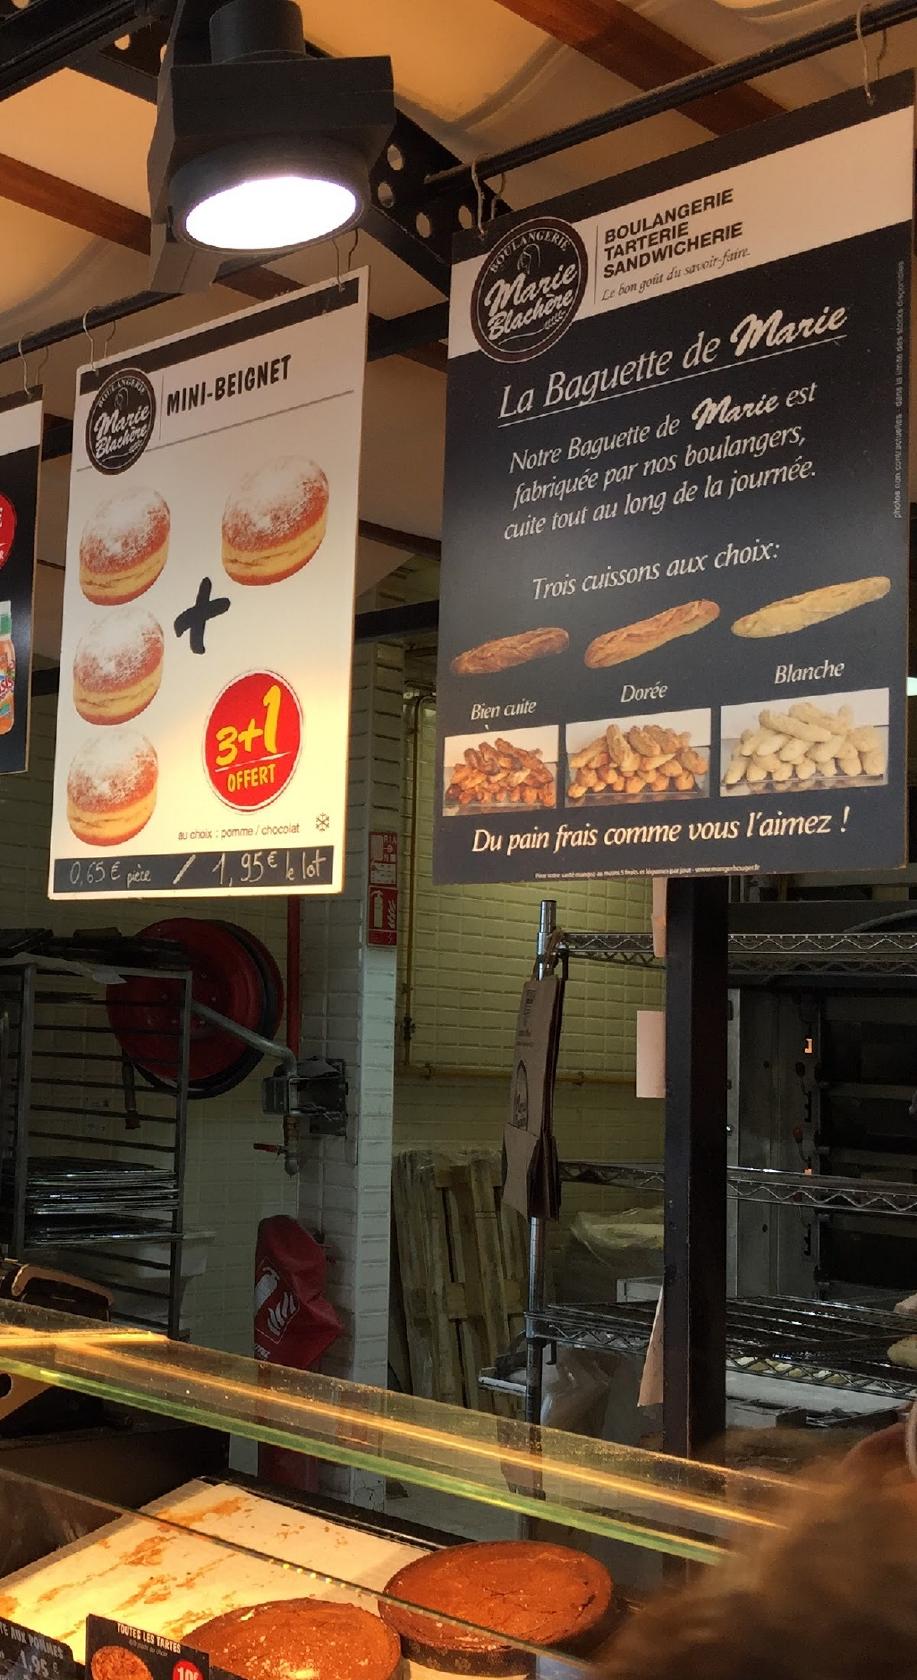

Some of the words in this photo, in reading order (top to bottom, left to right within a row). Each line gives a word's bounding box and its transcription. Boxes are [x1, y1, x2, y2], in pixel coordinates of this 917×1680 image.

[604, 188, 734, 245] BOULANGERIE
[490, 231, 571, 273] BOULANGERIE
[603, 222, 743, 279] SANDWICHERIE
[604, 221, 689, 261] TARTERIE
[484, 263, 578, 317] Marie
[601, 288, 616, 301] Le
[618, 282, 637, 296] bon
[639, 272, 663, 294] goût
[666, 266, 682, 281] du
[487, 289, 574, 341] Blachère
[499, 385, 534, 419] La
[543, 351, 674, 407] Baguette
[683, 331, 722, 370] de
[730, 305, 848, 356] Marie
[167, 354, 291, 416] MINI-BEIGNET
[94, 405, 149, 441] Marie
[95, 423, 148, 459] Blachère
[509, 445, 562, 474] Notre
[567, 422, 651, 461] Baguette
[656, 413, 681, 440] de
[692, 394, 779, 431] Marie
[785, 382, 818, 409] est
[512, 468, 599, 511] fabriquée
[603, 461, 640, 492] par
[643, 451, 678, 475] nos
[684, 423, 807, 468] boulangers,
[504, 514, 546, 540] cuite
[551, 507, 588, 532] tout
[592, 500, 618, 522] au
[623, 488, 667, 516] long
[672, 480, 699, 506] de
[703, 473, 724, 500] la
[728, 454, 817, 501] journée.
[531, 576, 576, 600] Trois
[581, 560, 661, 593] cuissons
[666, 552, 709, 578] aux
[714, 538, 781, 569] choix:
[620, 682, 669, 703] Dorée
[774, 660, 846, 685] Blanche
[215, 684, 282, 766] 3+1
[471, 702, 500, 720] Bien
[503, 698, 537, 716] cuite
[227, 763, 277, 793] OFFERT
[178, 830, 188, 840] au
[190, 829, 213, 839] choix
[221, 828, 254, 840] pomme
[261, 823, 300, 836] chocolat
[472, 828, 502, 852] Du
[507, 826, 550, 856] pain
[553, 823, 598, 854] frais
[603, 821, 682, 845] comme
[688, 819, 739, 841] vous
[746, 810, 832, 838] l'aimez
[126, 864, 151, 888] pièce
[285, 852, 296, 881] le
[302, 850, 327, 879] lot
[10, 1626, 27, 1644] AUX
[28, 1633, 64, 1660] POMMES
[117, 1622, 141, 1640] TOUTES
[143, 1632, 155, 1645] LES
[156, 1636, 181, 1654] TARTES
